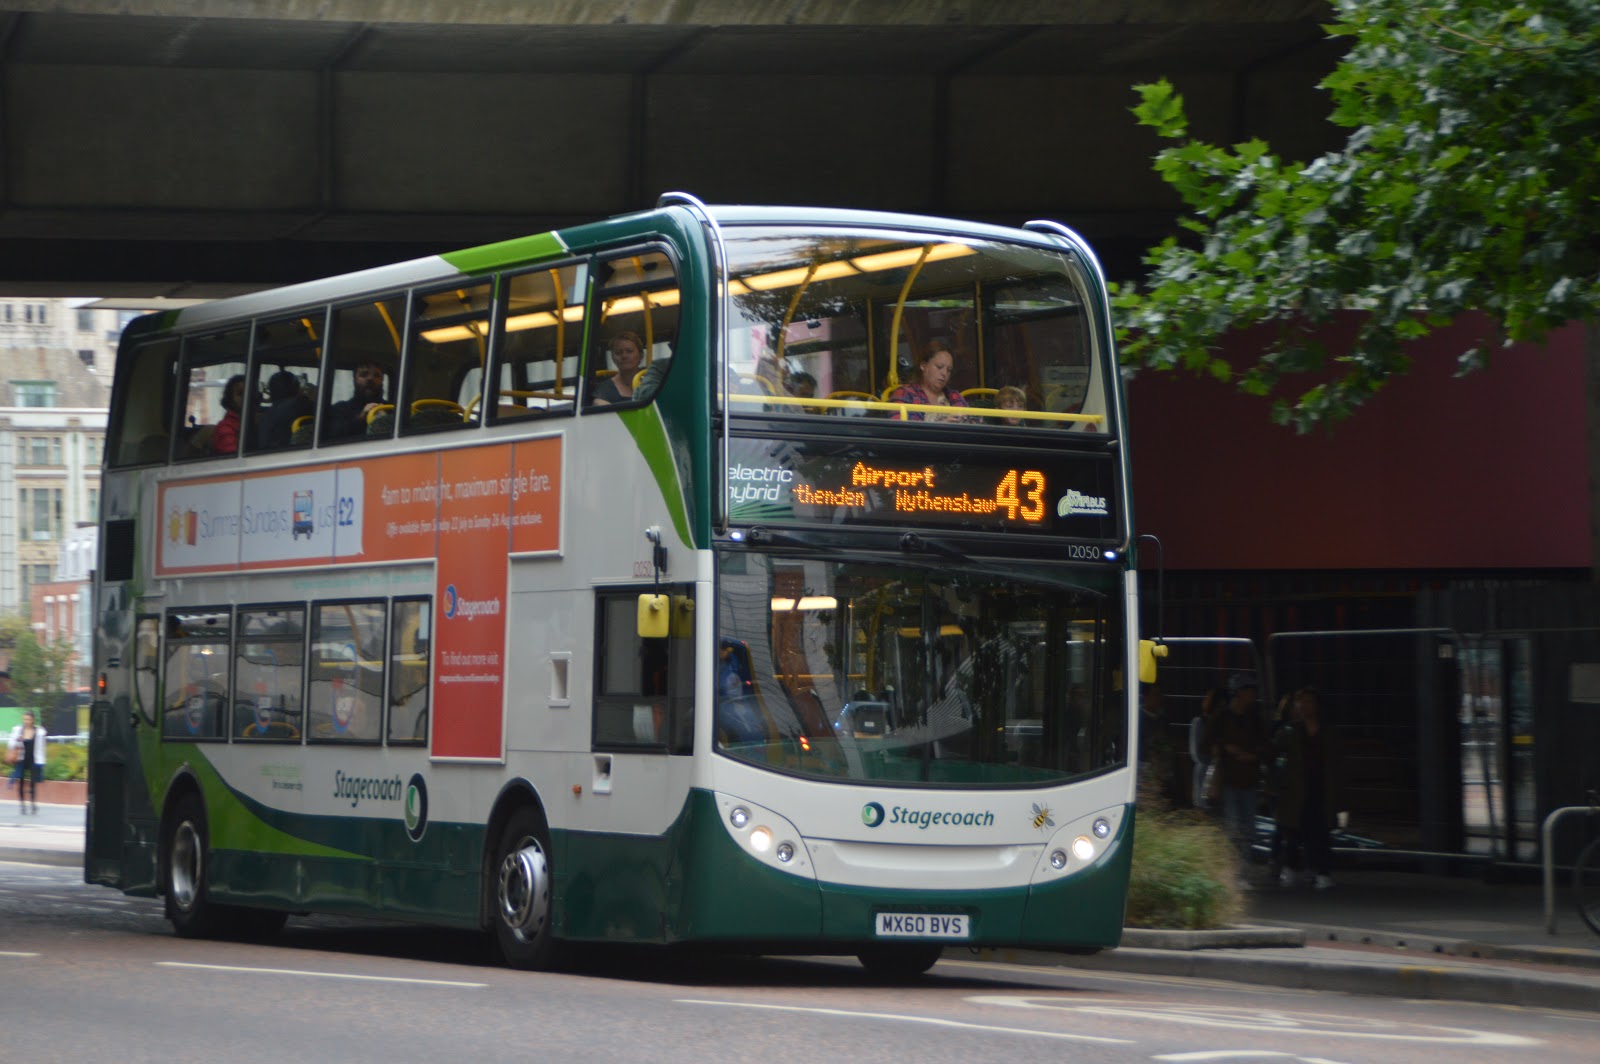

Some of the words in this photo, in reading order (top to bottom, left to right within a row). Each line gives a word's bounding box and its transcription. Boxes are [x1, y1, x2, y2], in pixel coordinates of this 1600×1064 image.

[455, 476, 497, 498] maximum
[500, 471, 527, 501] single
[530, 469, 551, 492] fare.
[729, 463, 793, 482] electric
[852, 462, 935, 488] Airport
[996, 469, 1045, 521] 43
[339, 497, 354, 527] £2
[1068, 545, 1100, 559] 12050
[333, 769, 402, 808] Stagecoach
[890, 806, 995, 830] Stagecoach
[883, 915, 925, 933] MX60
[930, 917, 962, 934] BVS
